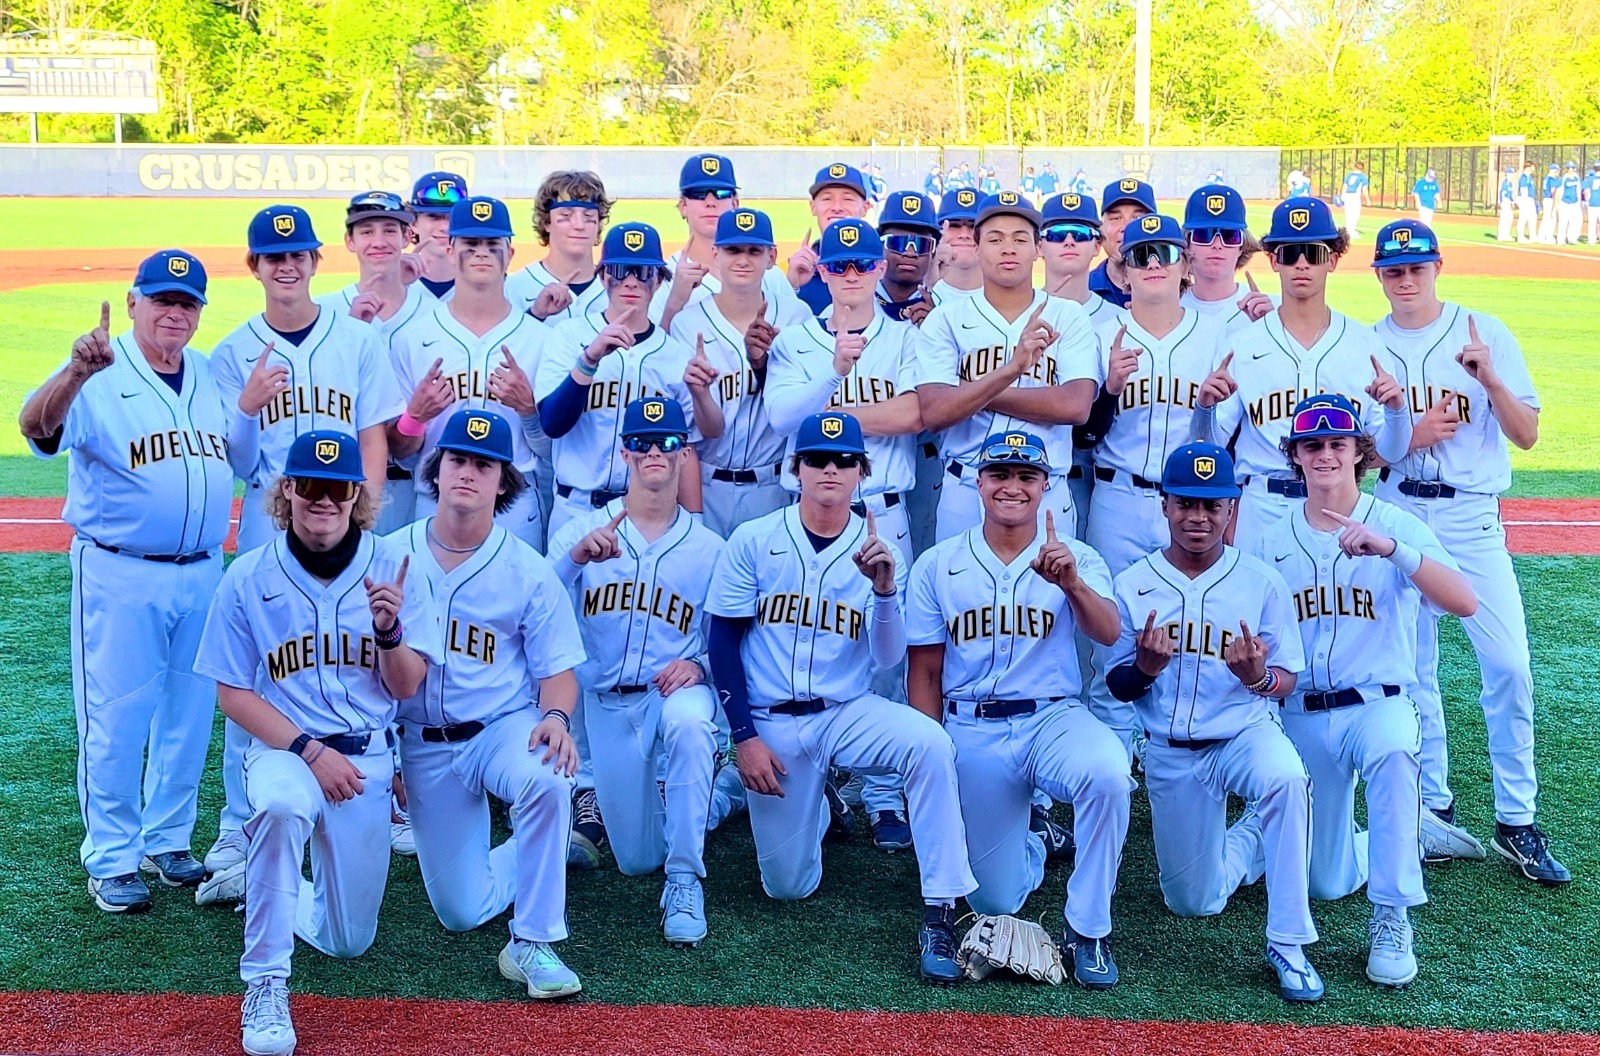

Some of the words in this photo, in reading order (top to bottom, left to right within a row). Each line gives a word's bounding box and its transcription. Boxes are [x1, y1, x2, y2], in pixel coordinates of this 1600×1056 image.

[703, 160, 718, 171] M
[831, 165, 845, 175] M
[138, 154, 410, 191] CRUSADERS
[1121, 180, 1136, 191] M
[903, 199, 919, 210] M
[959, 193, 973, 204] M
[1001, 193, 1016, 204] M
[1062, 195, 1079, 206] M
[1209, 198, 1224, 210] M
[474, 204, 490, 216] M
[276, 218, 293, 231] M
[737, 215, 754, 226] M
[1143, 219, 1159, 230] M
[1291, 212, 1307, 225] M
[626, 233, 643, 246] M
[841, 229, 857, 241] M
[1395, 231, 1410, 243] M
[172, 258, 187, 272] M
[1115, 376, 1199, 416] OELLE
[260, 386, 352, 431] OELLER
[646, 404, 662, 417] M
[471, 421, 487, 435] M
[824, 420, 842, 432] M
[1008, 437, 1023, 448] M
[318, 443, 335, 457] M
[1197, 460, 1213, 473] M
[584, 582, 694, 636] MOELLER
[757, 594, 863, 642] MOELLER
[946, 605, 1055, 647] MOELLER
[1161, 622, 1233, 660] ELLE
